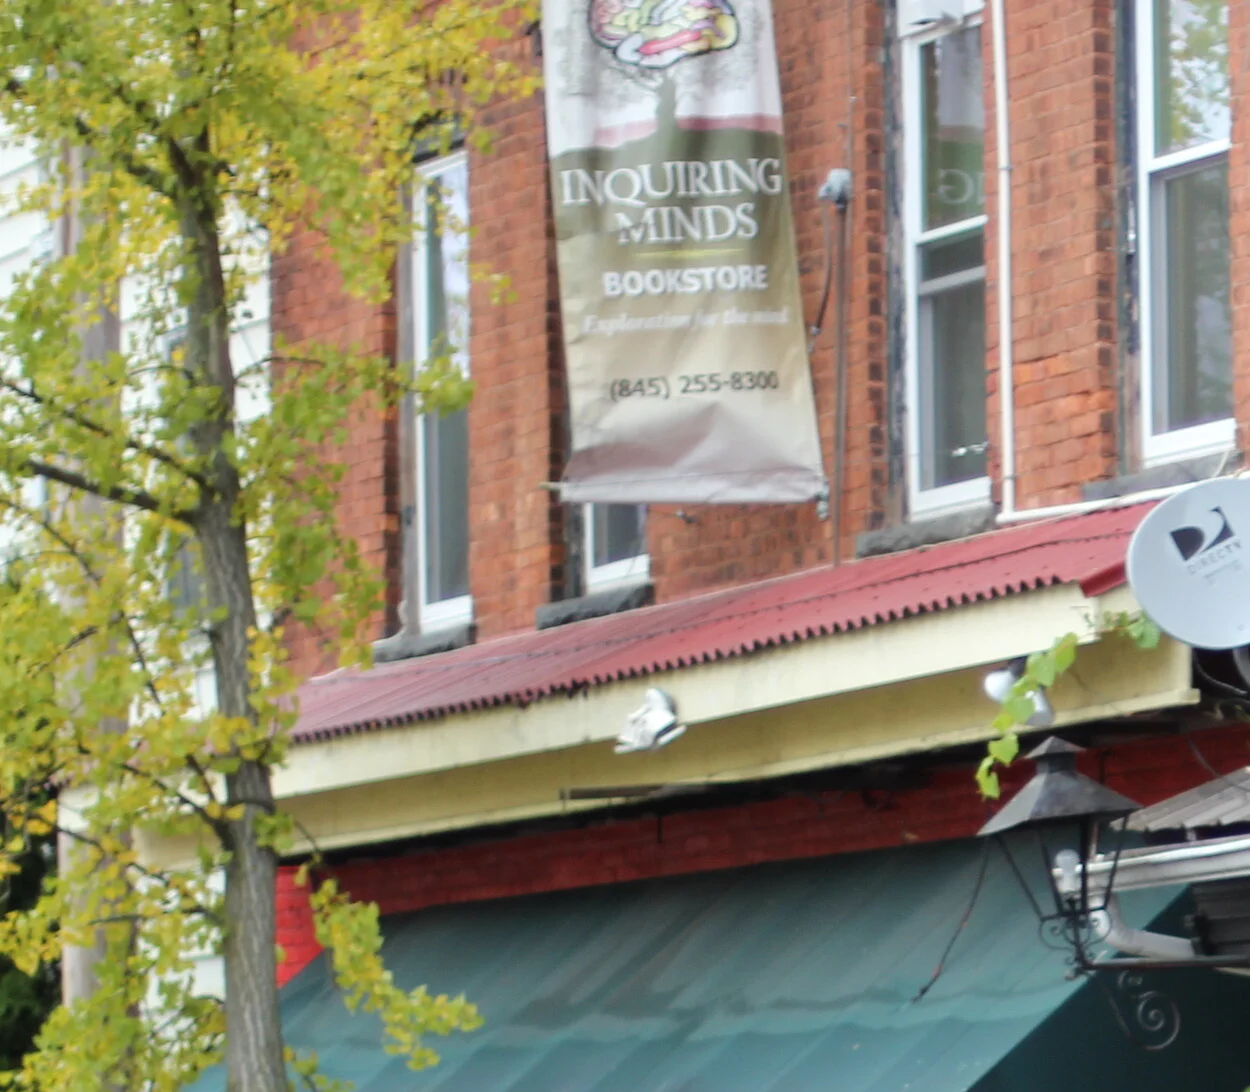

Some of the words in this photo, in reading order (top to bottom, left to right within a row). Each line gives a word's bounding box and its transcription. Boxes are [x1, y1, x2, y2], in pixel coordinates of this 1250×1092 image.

[560, 158, 783, 208] INQUIRING
[614, 202, 759, 244] MINDS
[603, 263, 769, 296] BOOKSTORE
[610, 376, 670, 403] (845)
[679, 369, 780, 394] 255-8300
